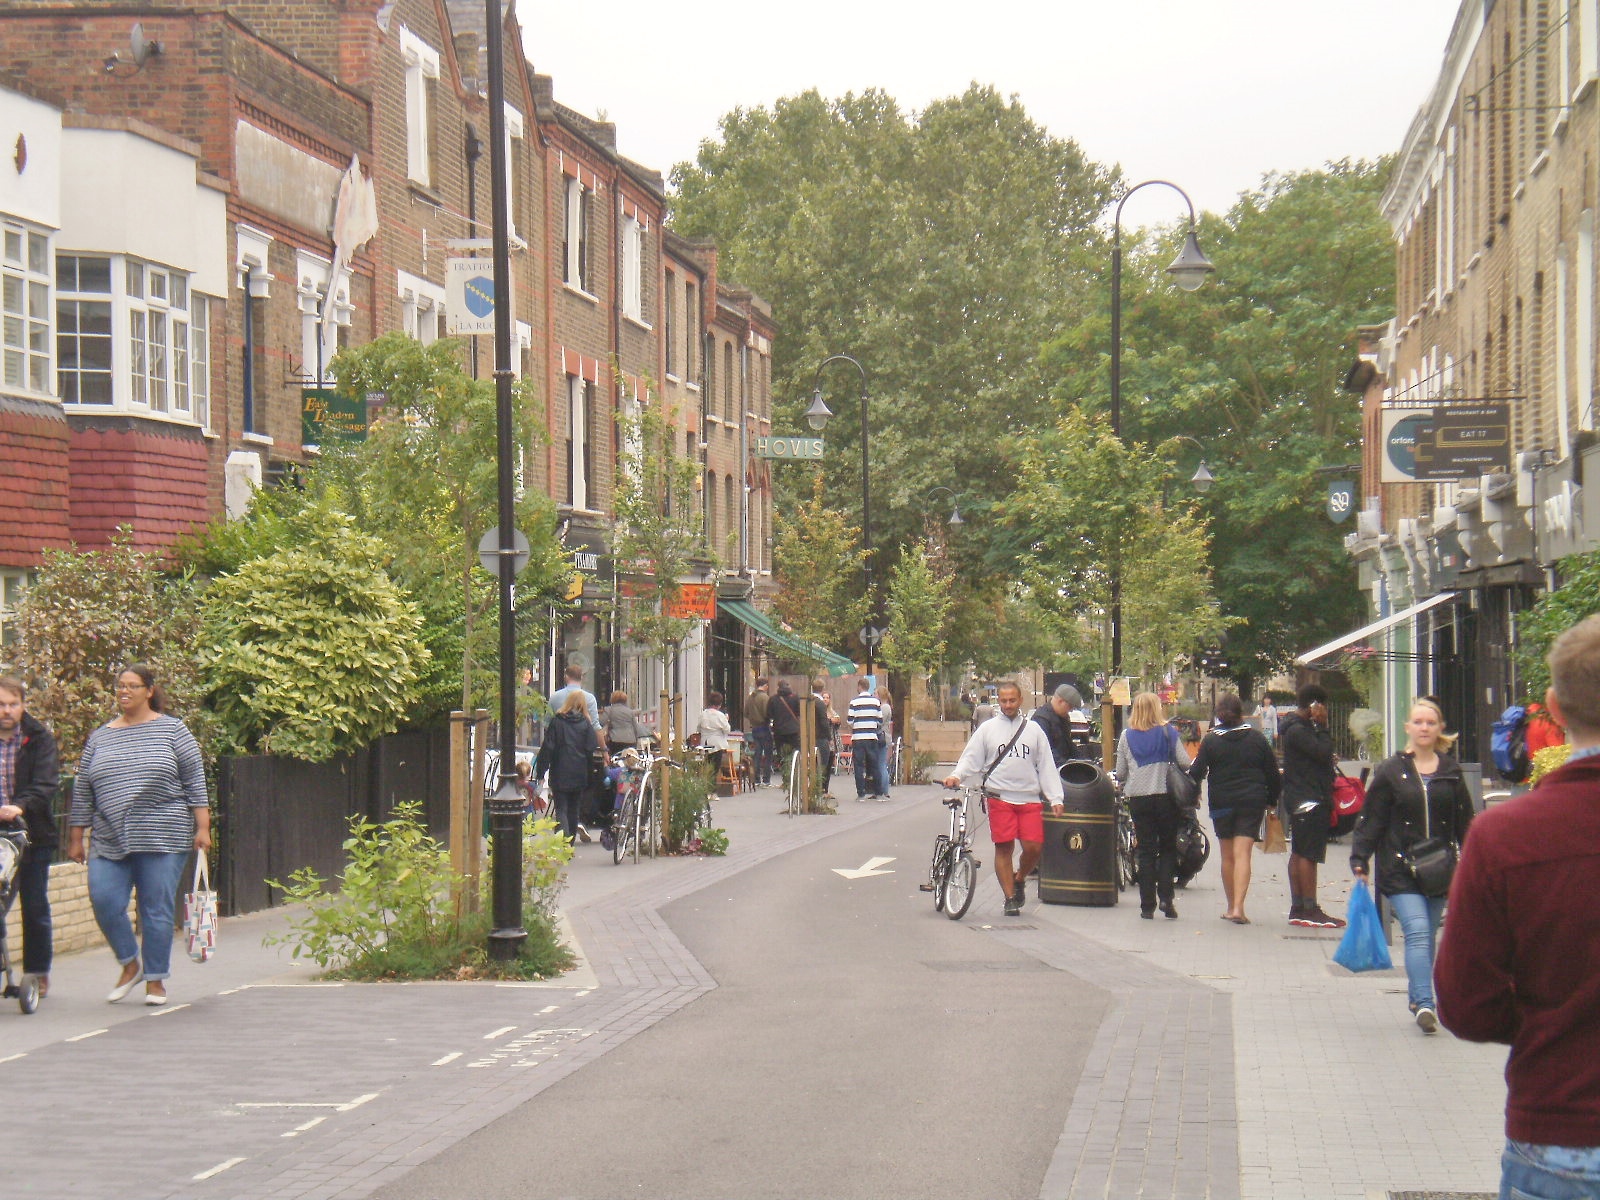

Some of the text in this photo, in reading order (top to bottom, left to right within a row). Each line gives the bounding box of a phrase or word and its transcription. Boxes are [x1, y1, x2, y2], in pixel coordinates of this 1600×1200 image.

[460, 322, 472, 330] LA
[304, 397, 328, 411] East
[325, 423, 366, 432] sage
[757, 439, 823, 456] HOVIS
